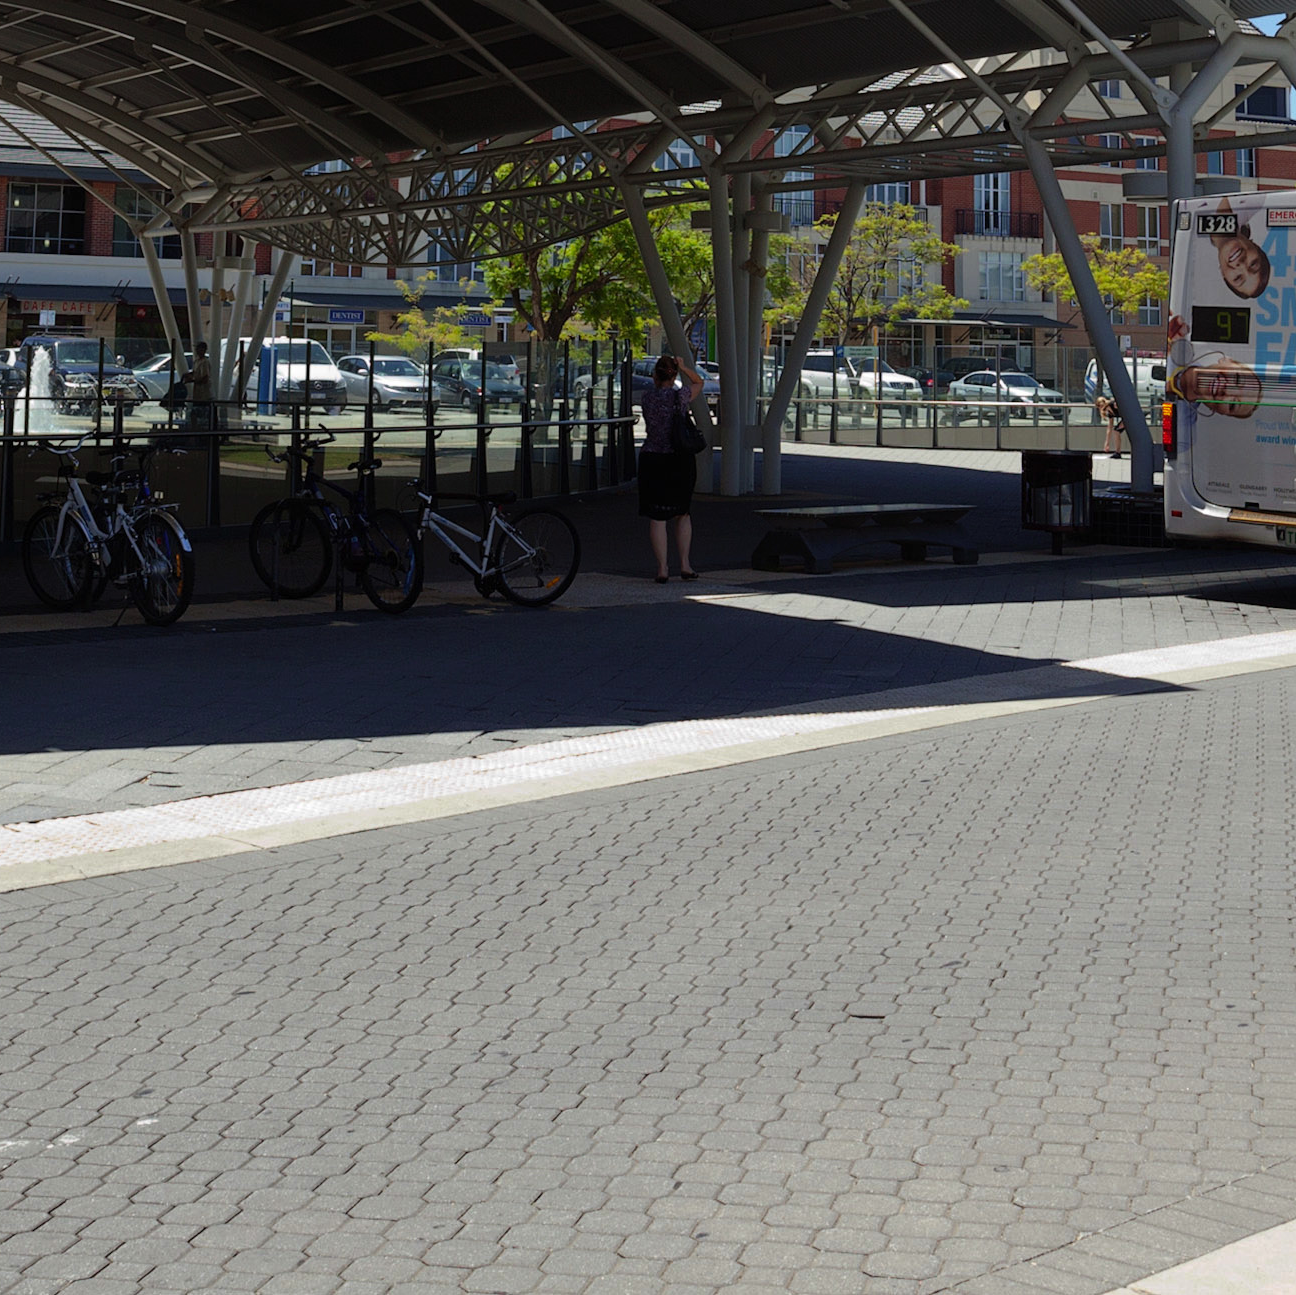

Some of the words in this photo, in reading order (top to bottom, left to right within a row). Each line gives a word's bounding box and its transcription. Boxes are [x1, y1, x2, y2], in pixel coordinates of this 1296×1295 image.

[1199, 215, 1236, 232] 1328
[332, 312, 362, 320] DENTIST
[1256, 435, 1280, 444] award
